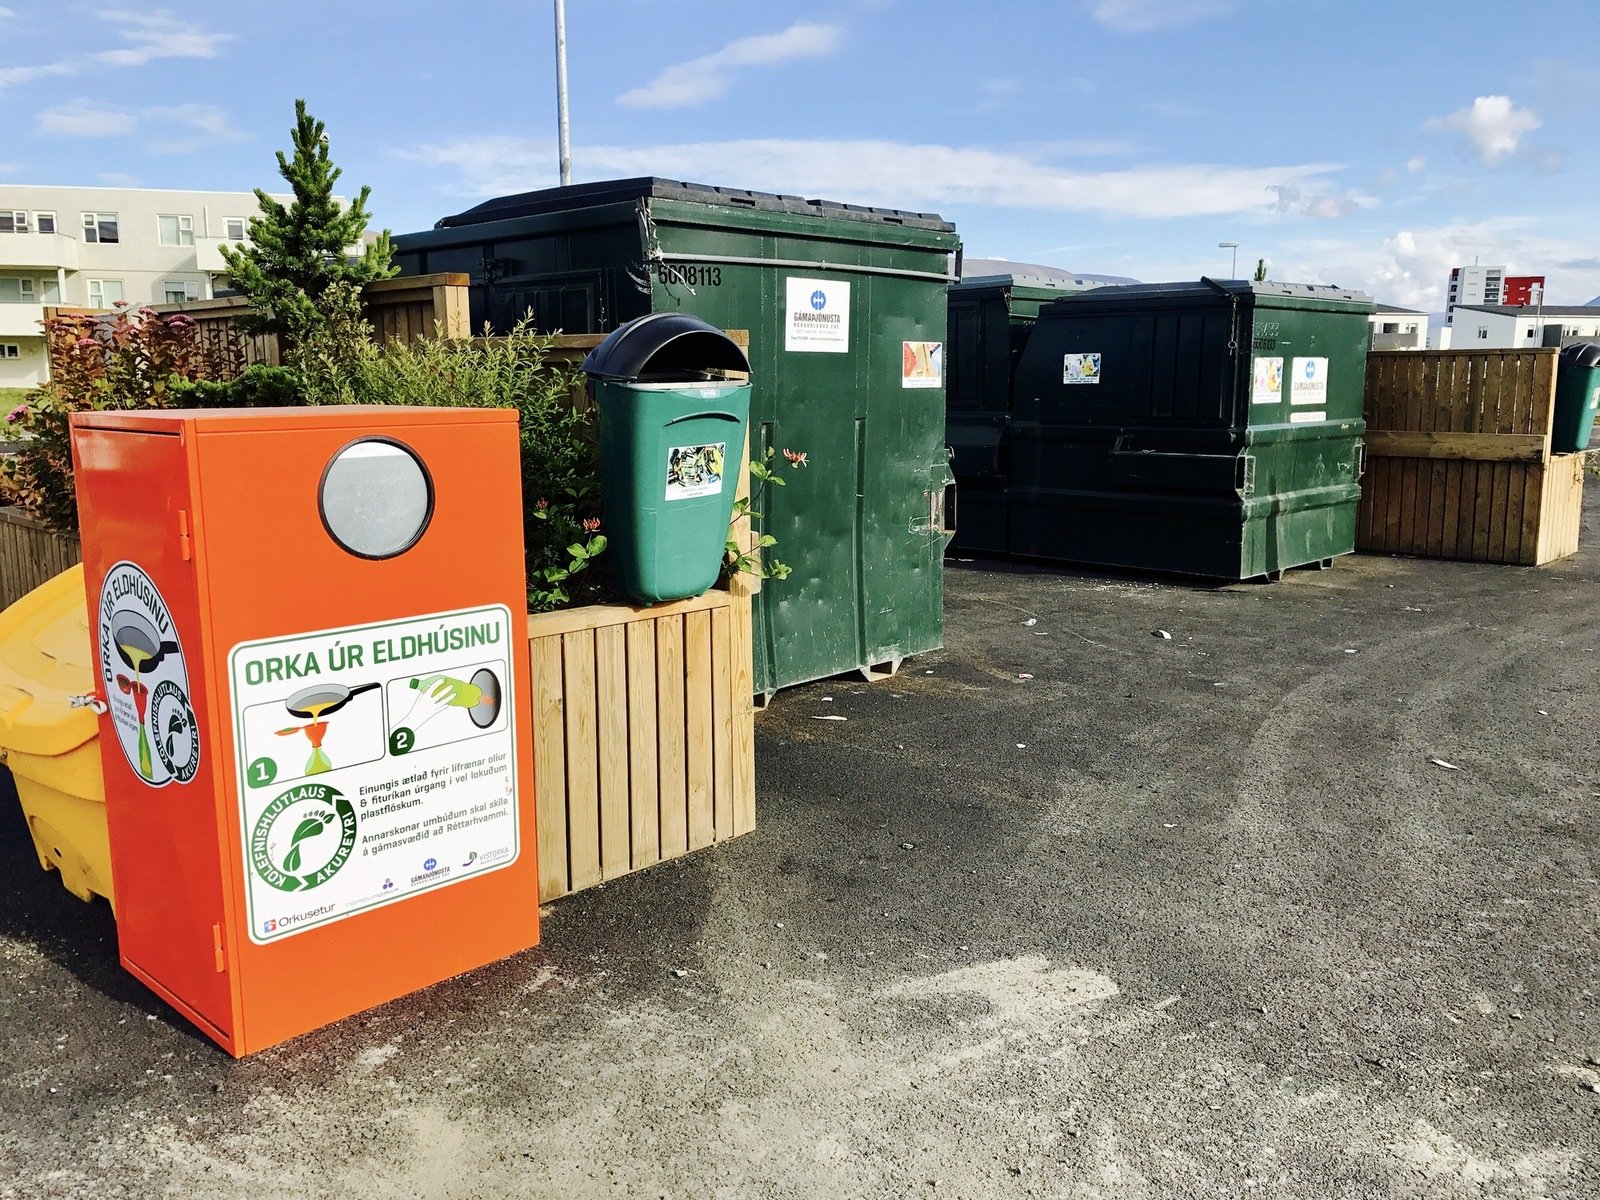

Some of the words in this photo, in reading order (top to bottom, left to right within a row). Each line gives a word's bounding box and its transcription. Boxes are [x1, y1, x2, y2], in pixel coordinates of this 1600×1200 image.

[102, 623, 113, 682] ORKA
[112, 574, 169, 634] ELDHÚSINU
[245, 651, 321, 686] ORKA
[328, 640, 364, 672] ÚR
[373, 621, 501, 664] ELDHÚSINU
[181, 725, 198, 780] AKUREYRI
[396, 732, 408, 750] 2
[256, 763, 270, 782] 1
[359, 779, 399, 796] Einungis
[402, 771, 428, 786] ætlað
[431, 766, 450, 780] fyrir
[451, 757, 486, 773] lífrænar
[360, 799, 368, 808] &
[371, 788, 411, 806] fituríkan
[414, 779, 446, 795] úrgang
[455, 773, 468, 783] vel
[471, 764, 507, 780] lokuðum
[360, 797, 424, 822] plastflöskum.
[362, 822, 420, 845] Annarskonar
[423, 809, 468, 828] umbúðum
[469, 804, 487, 816] skal
[489, 797, 508, 809] skila
[363, 847, 369, 857] á
[433, 825, 444, 836] að
[447, 807, 509, 832] Réttarhvammi.
[254, 786, 327, 887] KOLEFNISHLUTLAUS
[316, 811, 355, 884] AKUREYRI
[278, 903, 336, 928] Orkusetur
